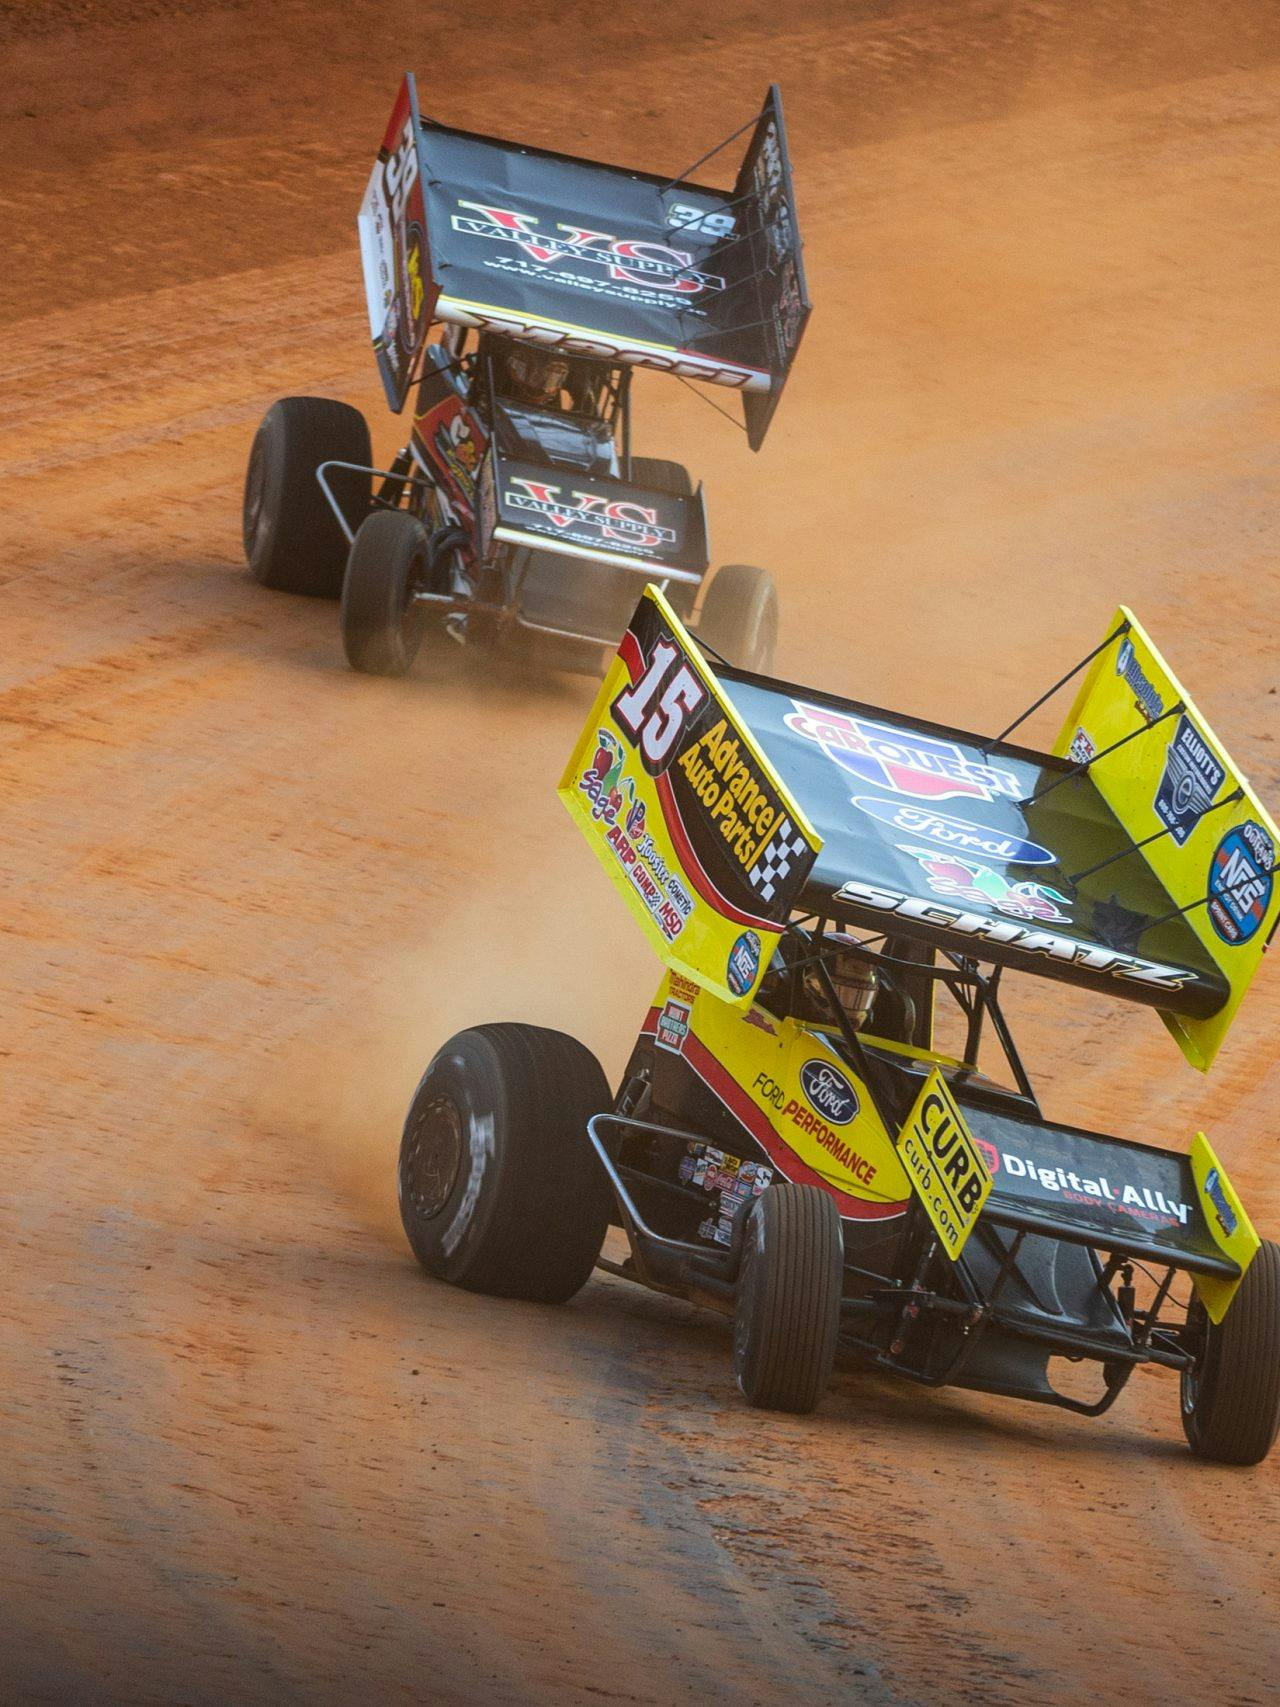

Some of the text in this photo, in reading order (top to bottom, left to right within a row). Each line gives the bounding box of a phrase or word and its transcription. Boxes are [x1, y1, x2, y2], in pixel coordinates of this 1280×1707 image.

[466, 221, 705, 285] VALLEY SUPPY
[514, 496, 667, 539] VALLEY SUPPLY
[614, 640, 704, 763] 15
[699, 718, 775, 837] Advance
[783, 711, 1025, 801] CARQUEST
[1181, 727, 1222, 786] ELLIOTT'S
[677, 742, 756, 864] Auto Parts
[892, 807, 1018, 859] Ford
[606, 825, 637, 865] ARP
[632, 864, 657, 897] COMP
[667, 879, 692, 916] COMETIC
[658, 900, 684, 936] MSD
[836, 882, 1201, 991] SCHATZ
[808, 1068, 852, 1118] Ford
[752, 1072, 787, 1111] FORD
[781, 1099, 878, 1186] PERFORMANCE
[920, 1093, 984, 1214] CURB
[904, 1139, 960, 1247] curb.com
[1002, 1153, 1116, 1201] Digital
